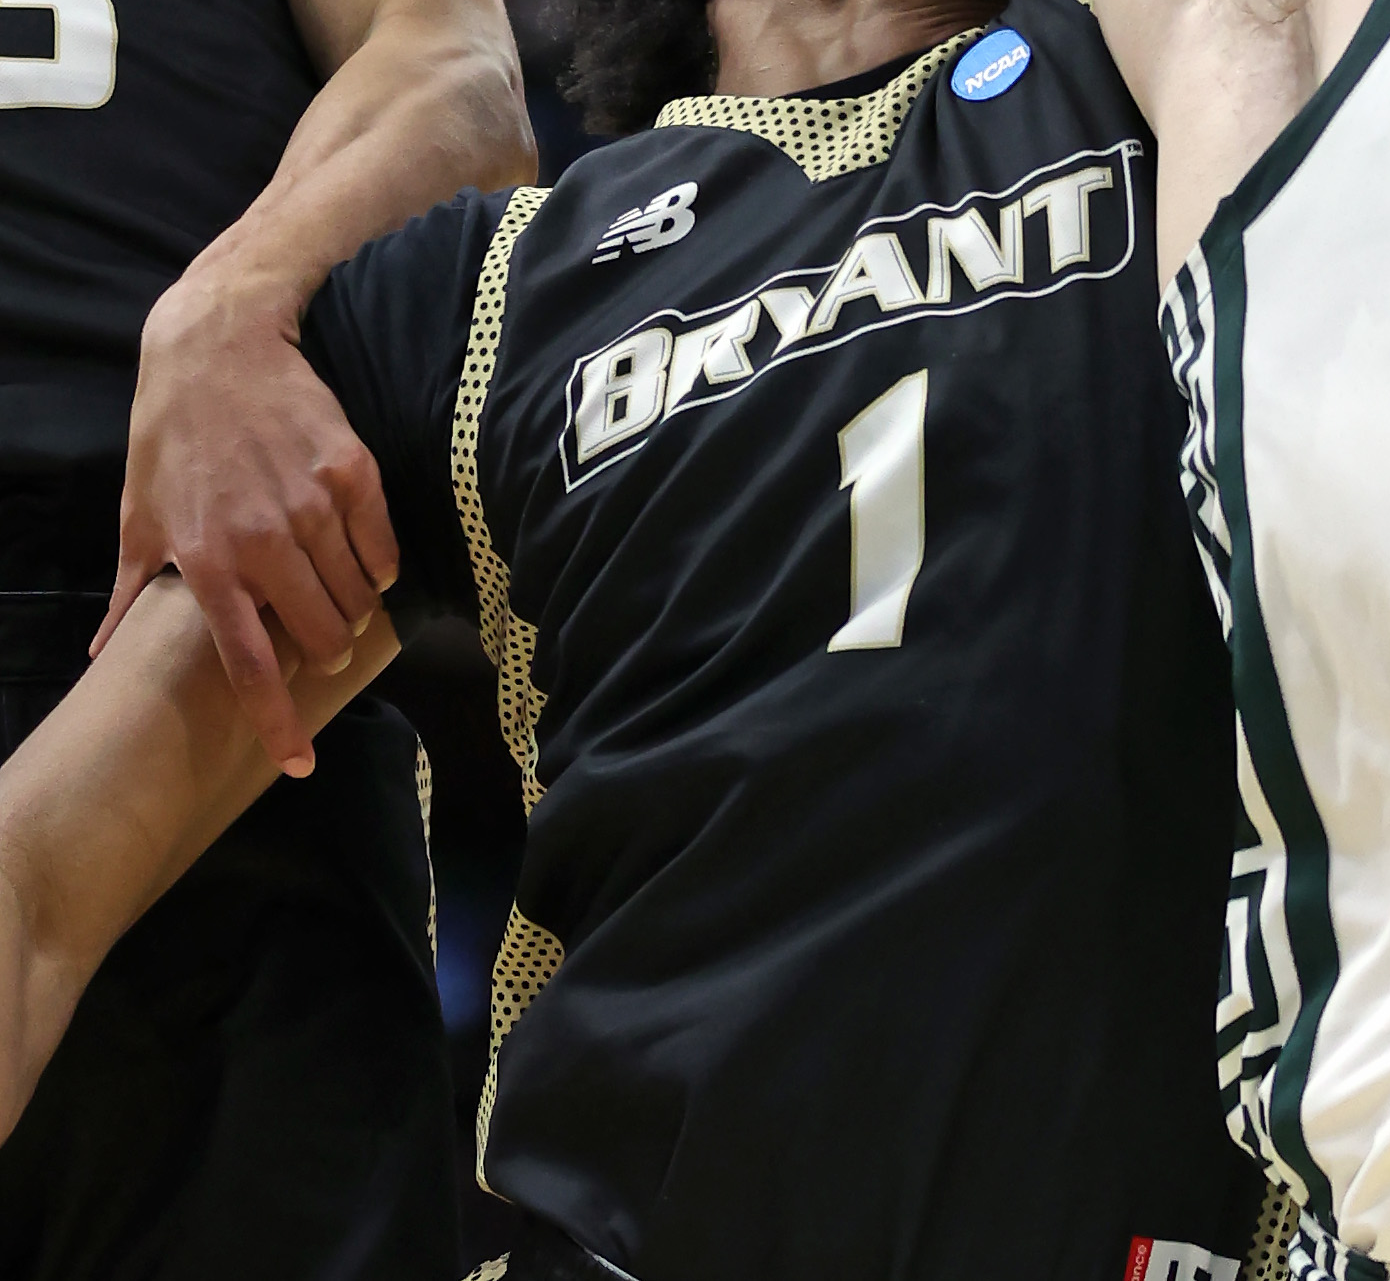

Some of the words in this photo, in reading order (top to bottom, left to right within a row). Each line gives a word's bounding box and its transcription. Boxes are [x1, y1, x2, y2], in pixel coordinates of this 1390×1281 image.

[964, 44, 1029, 95] NCAA
[575, 165, 1114, 466] BRYANT
[826, 368, 929, 654] 1
